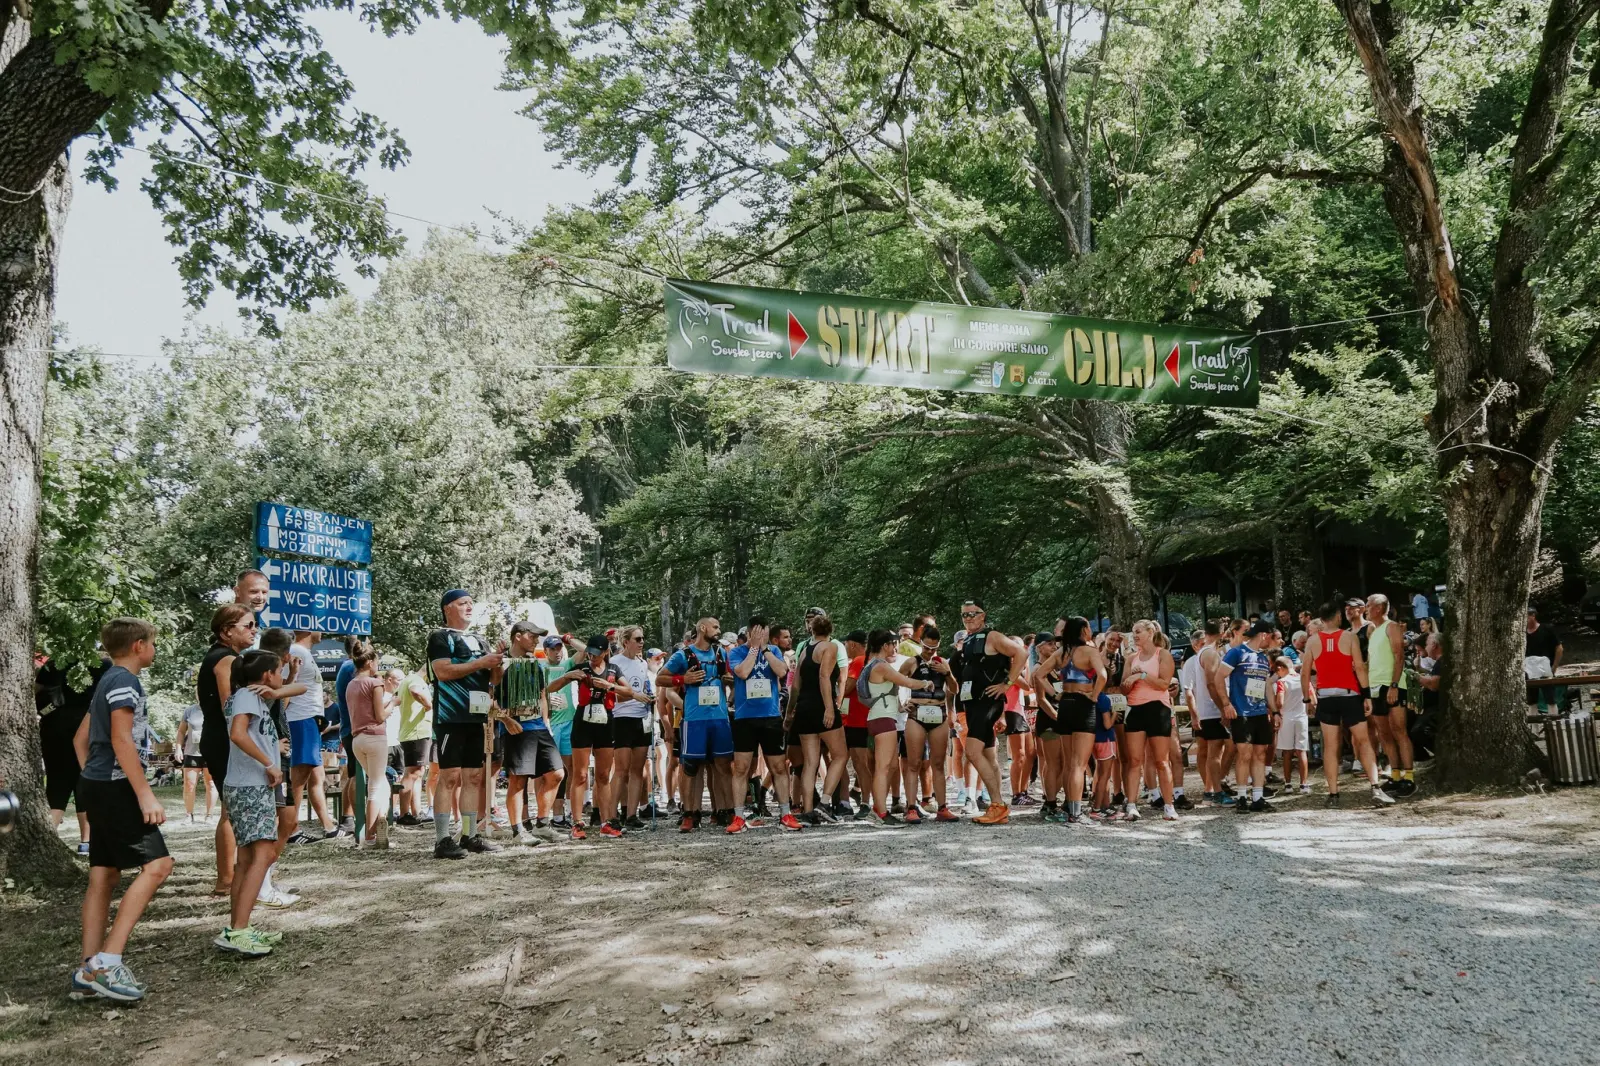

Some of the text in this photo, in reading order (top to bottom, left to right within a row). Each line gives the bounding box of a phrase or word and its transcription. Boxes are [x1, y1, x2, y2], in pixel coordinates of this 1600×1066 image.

[711, 303, 773, 337] Trail
[969, 320, 1031, 337] MENS SANA
[817, 305, 936, 375] START
[952, 337, 1049, 356] IN CORPORE SANO
[750, 347, 783, 362] jezero
[1063, 327, 1157, 390] CILJ
[1185, 340, 1229, 370] Trail
[1027, 376, 1058, 387] ČAGLIN
[284, 517, 343, 536] PRISTUP
[285, 507, 365, 530] ZABRANJEN
[278, 528, 347, 549] MOTORNIM
[279, 540, 342, 558] VOZILIMA
[282, 612, 370, 634] VIDIKOVAC
[706, 689, 716, 697] 39
[753, 681, 764, 690] 62
[592, 706, 603, 715] 36
[925, 708, 936, 716] 56
